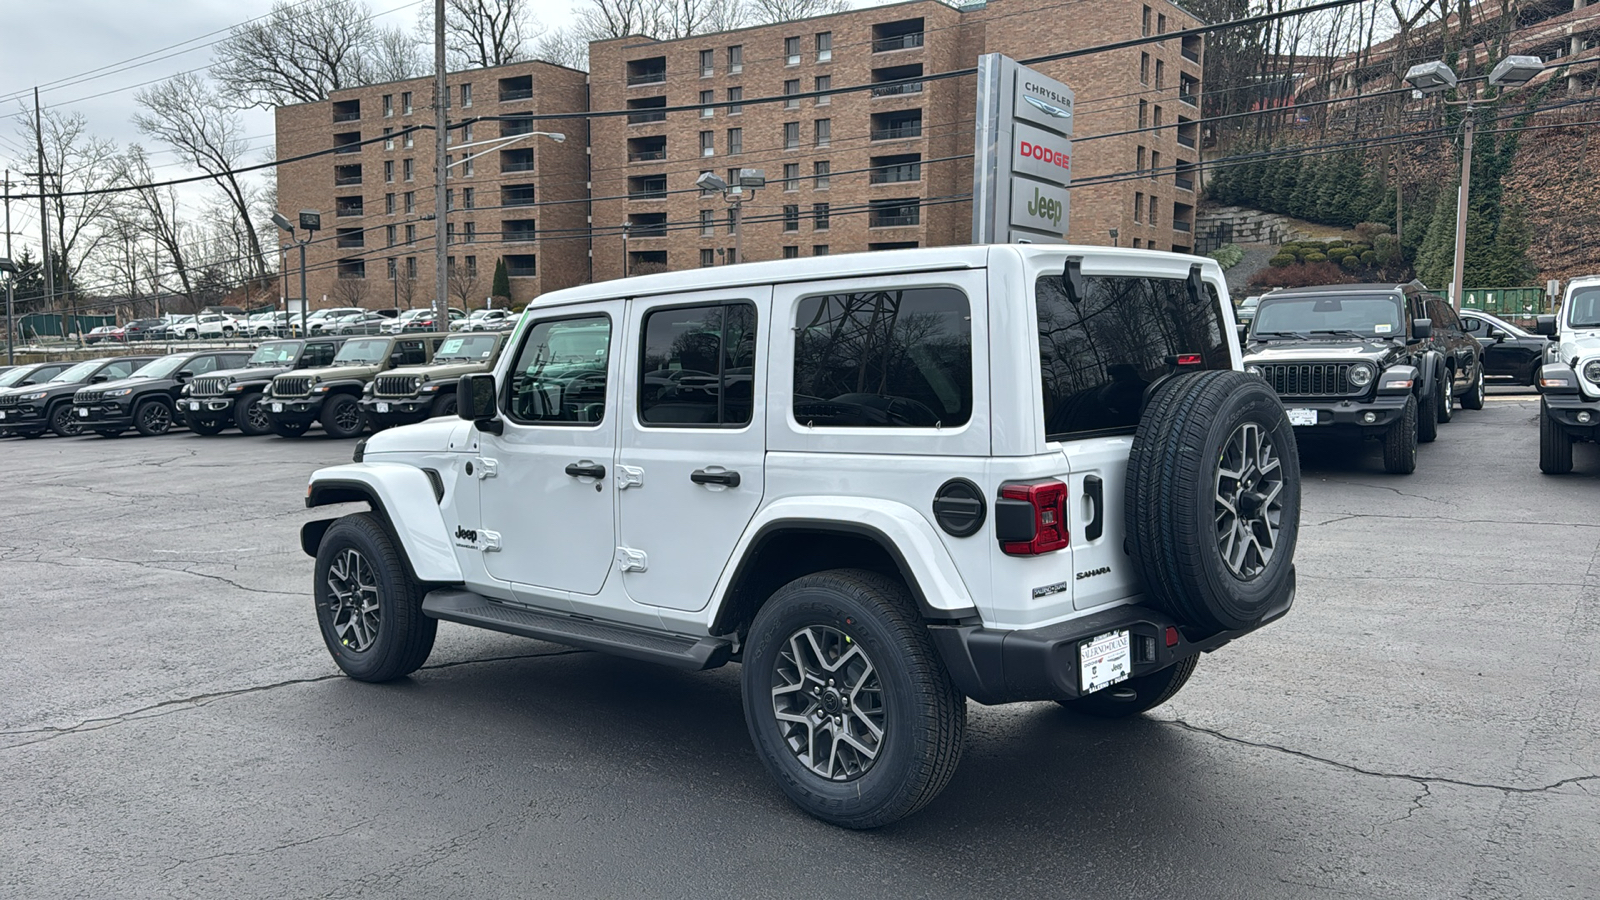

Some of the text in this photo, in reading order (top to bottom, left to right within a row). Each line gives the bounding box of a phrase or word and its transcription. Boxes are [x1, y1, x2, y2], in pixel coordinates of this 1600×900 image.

[1025, 82, 1071, 107] CHRYSLER
[1020, 141, 1070, 170] DODGE
[1027, 186, 1063, 227] Jeep
[455, 525, 477, 543] Jeep
[1076, 566, 1111, 580] SAHARA
[1081, 644, 1107, 659] SALERNO
[1108, 637, 1128, 651] DUANE
[1111, 663, 1123, 672] Jeep
